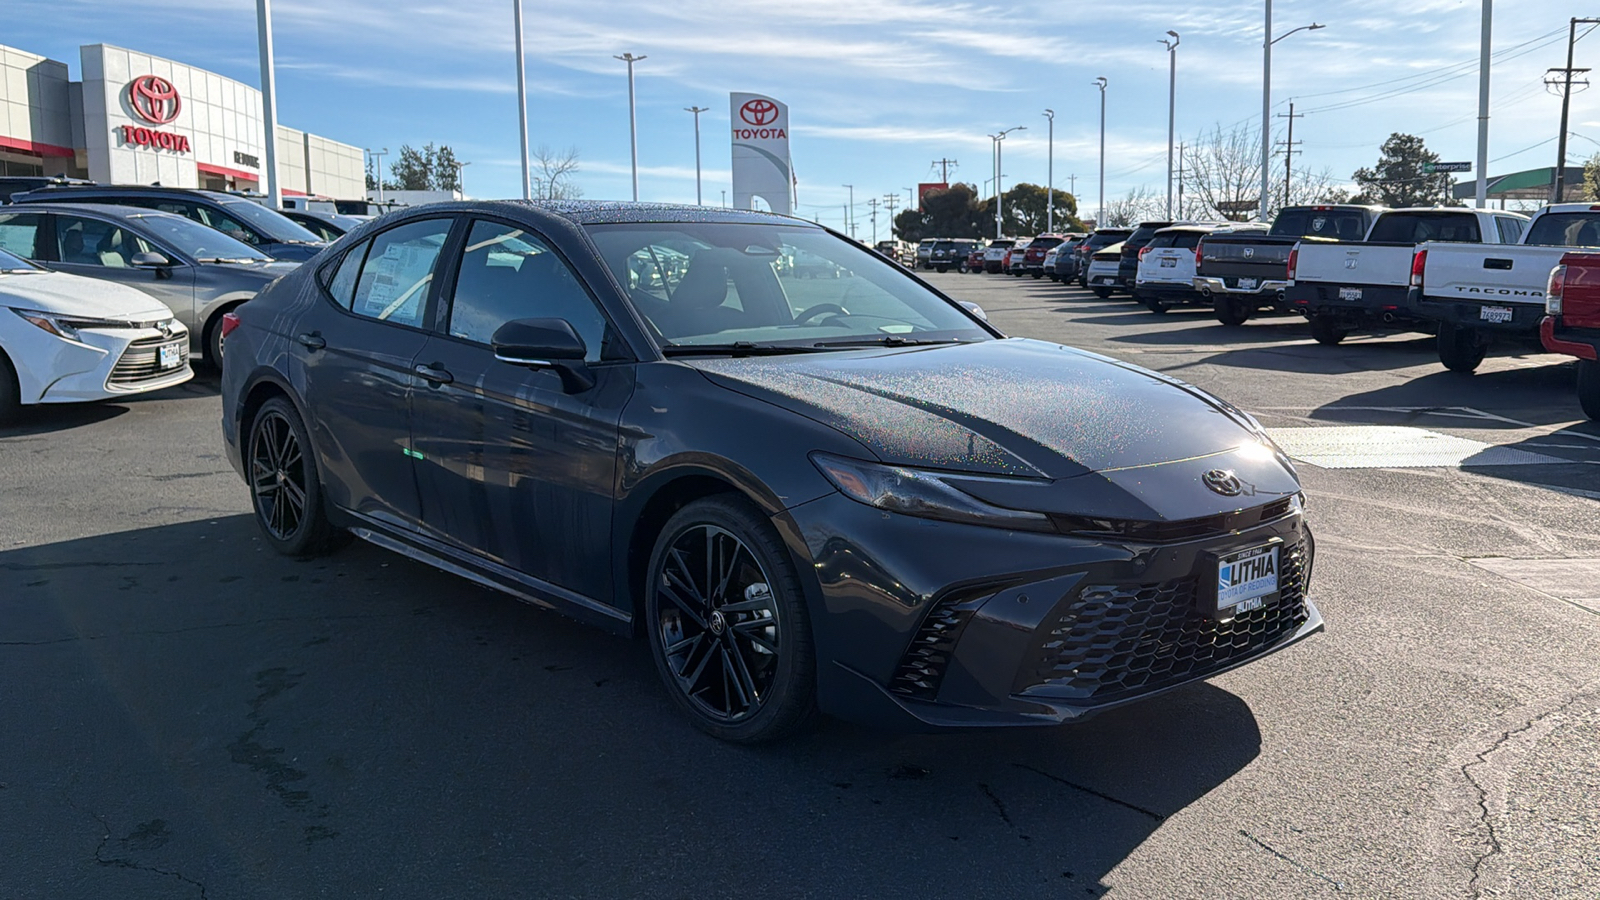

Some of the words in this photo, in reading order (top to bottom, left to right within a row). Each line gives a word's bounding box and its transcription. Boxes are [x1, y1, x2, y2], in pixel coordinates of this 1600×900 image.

[121, 125, 191, 153] TOYOTA
[733, 128, 787, 140] TOYOTA
[1427, 163, 1471, 171] enterprise
[1455, 286, 1543, 297] TACOMA
[1237, 550, 1252, 560] SINCE
[1230, 554, 1275, 587] LITHIA
[1218, 588, 1238, 601] TOYOTA
[1239, 583, 1247, 595] OF
[1247, 576, 1276, 592] REDDING
